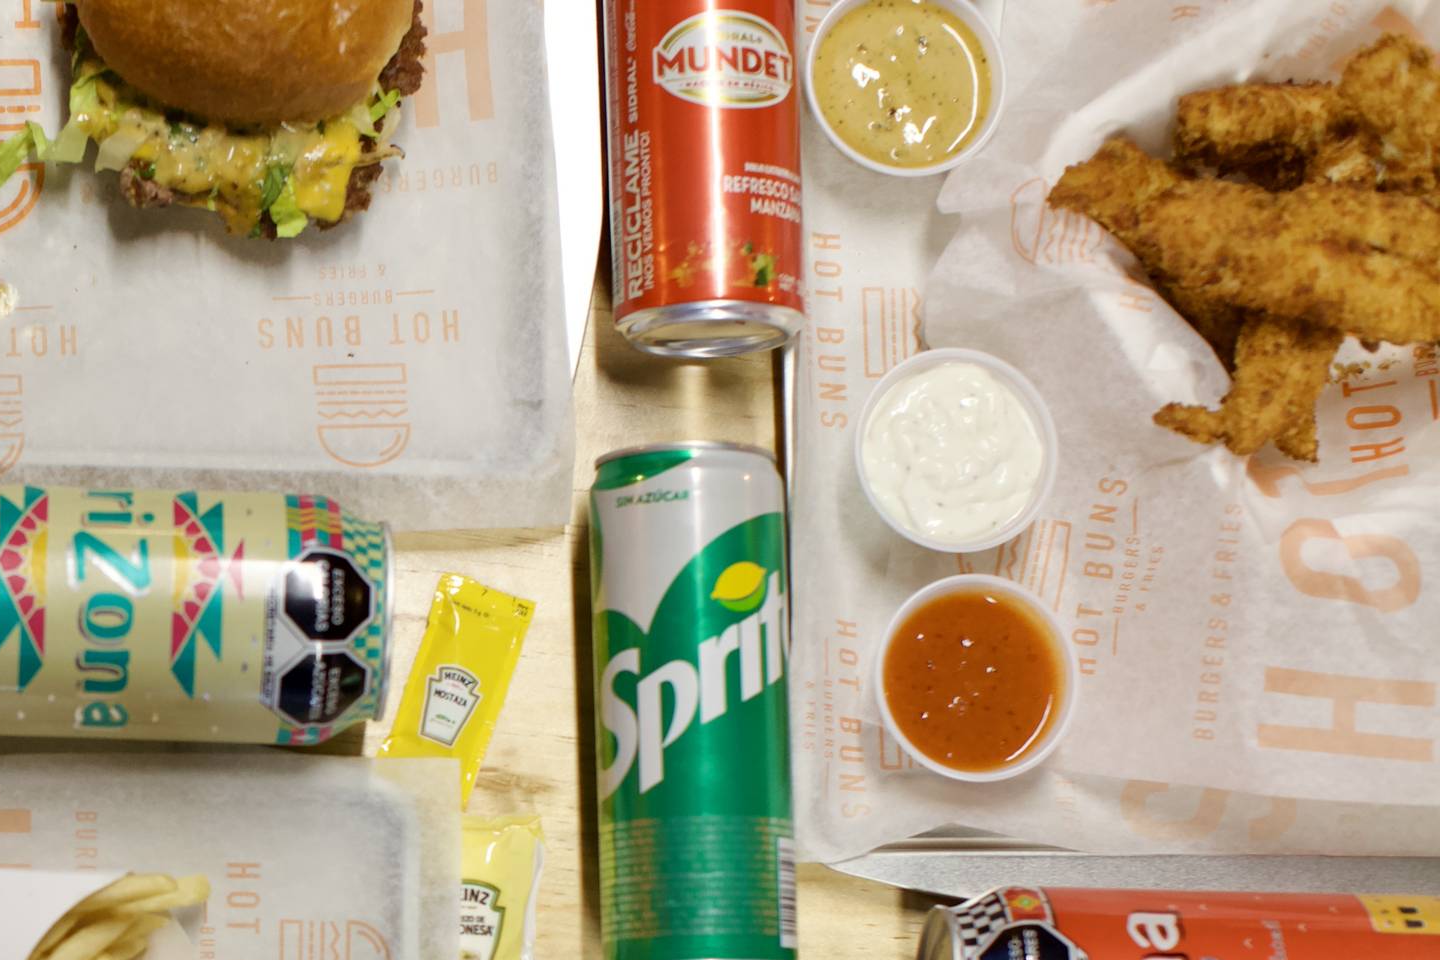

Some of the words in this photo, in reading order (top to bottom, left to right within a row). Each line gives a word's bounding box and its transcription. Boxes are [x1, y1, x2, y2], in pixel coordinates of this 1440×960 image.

[656, 46, 791, 82] MUNDET
[640, 200, 654, 251] VEMOS
[811, 231, 842, 302] HOT
[311, 287, 395, 306] BURGERS
[6, 324, 78, 357] HOT
[256, 314, 363, 350] BUNS
[389, 310, 461, 346] HOT
[815, 326, 848, 432] BUNS
[1341, 379, 1407, 464] HOT
[1083, 476, 1128, 581] BUNS
[331, 567, 345, 626] EXCESO
[1112, 535, 1141, 615] BURGERS
[1193, 616, 1229, 741] BURGERS
[1215, 502, 1243, 581] FRIES
[444, 670, 474, 687] HEINZ
[834, 618, 860, 695] HOT
[433, 689, 469, 708] MOSTAZA
[838, 715, 871, 818] BUNS
[225, 861, 262, 935] HOT
[459, 887, 491, 906] INZ
